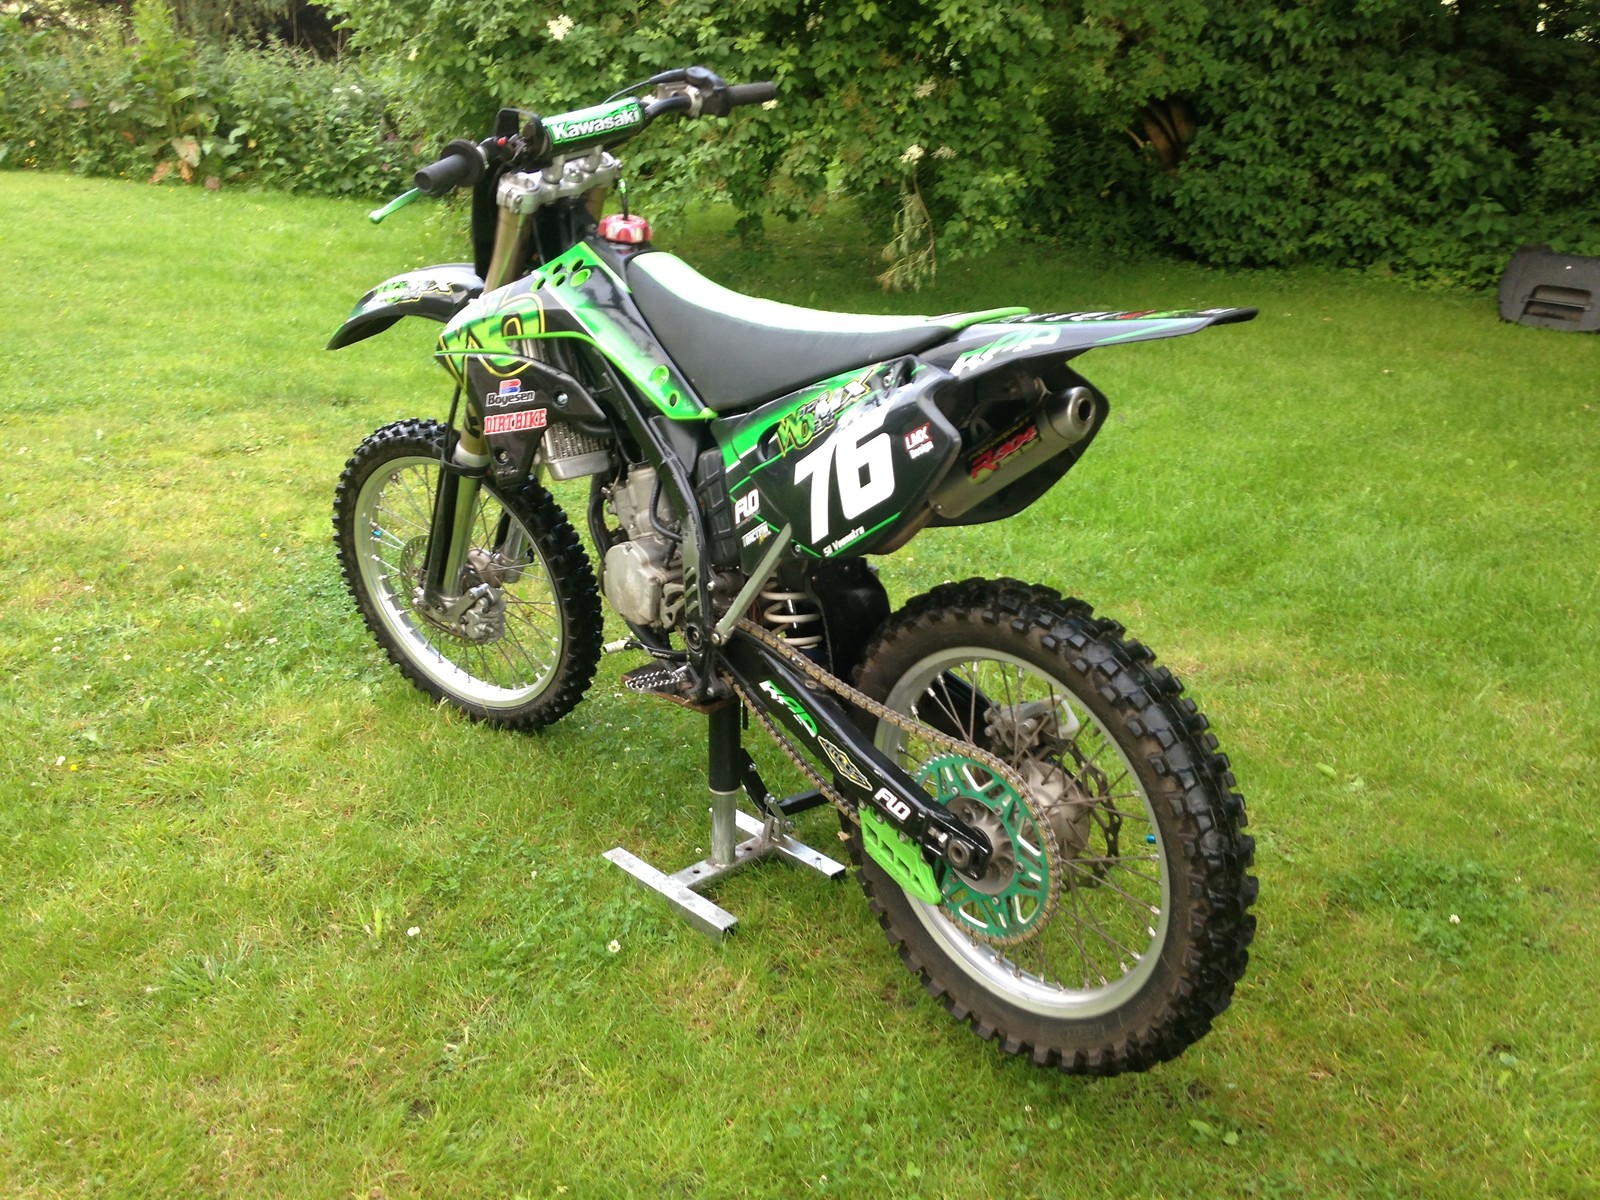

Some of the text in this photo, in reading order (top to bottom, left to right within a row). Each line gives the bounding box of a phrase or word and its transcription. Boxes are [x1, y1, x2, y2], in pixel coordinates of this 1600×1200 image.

[551, 106, 641, 141] Kawasaki
[486, 390, 535, 407] Boyesen
[484, 408, 547, 434] DIRT BIKE
[794, 402, 895, 545] 76
[874, 787, 911, 821] FLO
